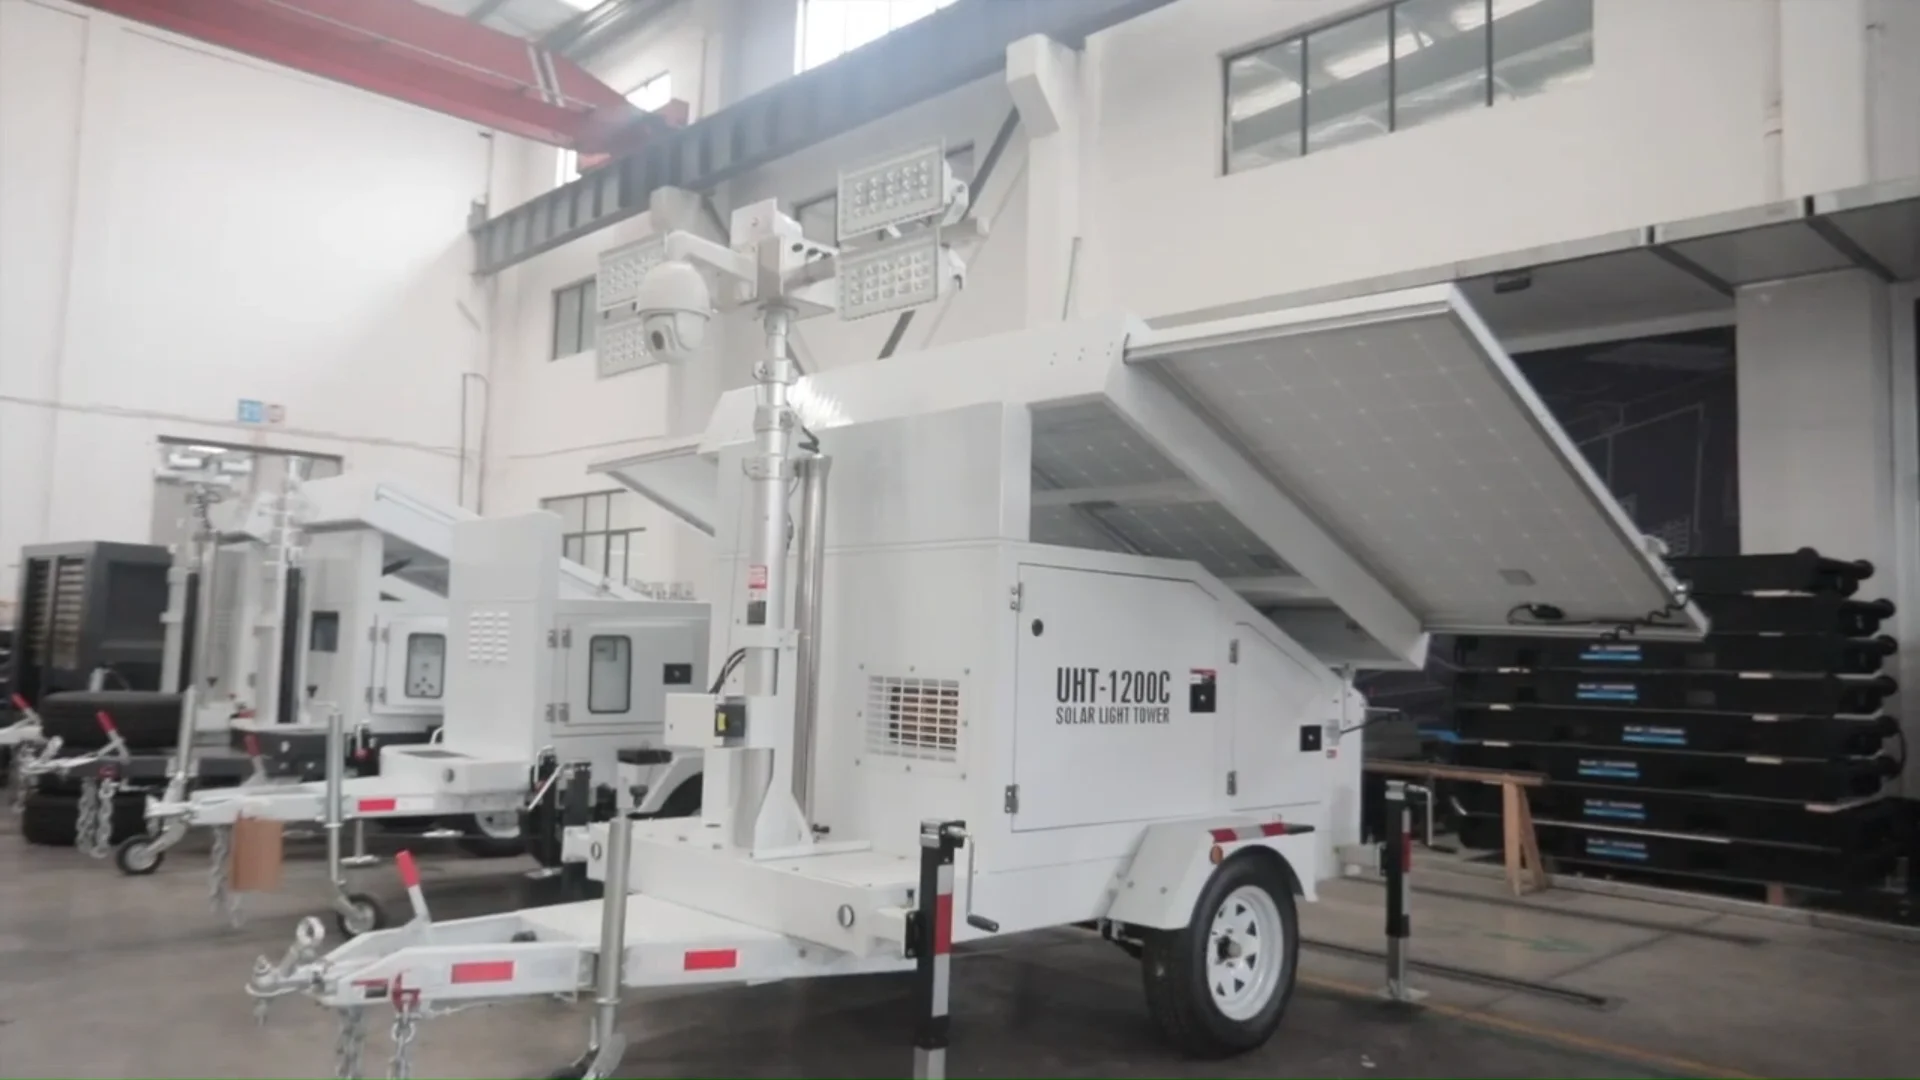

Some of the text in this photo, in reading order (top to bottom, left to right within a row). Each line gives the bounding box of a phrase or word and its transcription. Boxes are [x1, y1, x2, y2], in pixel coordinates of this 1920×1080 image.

[1057, 667, 1170, 703] UHT-1200C
[1056, 706, 1169, 724] SOLAR LIGHT TOWER
